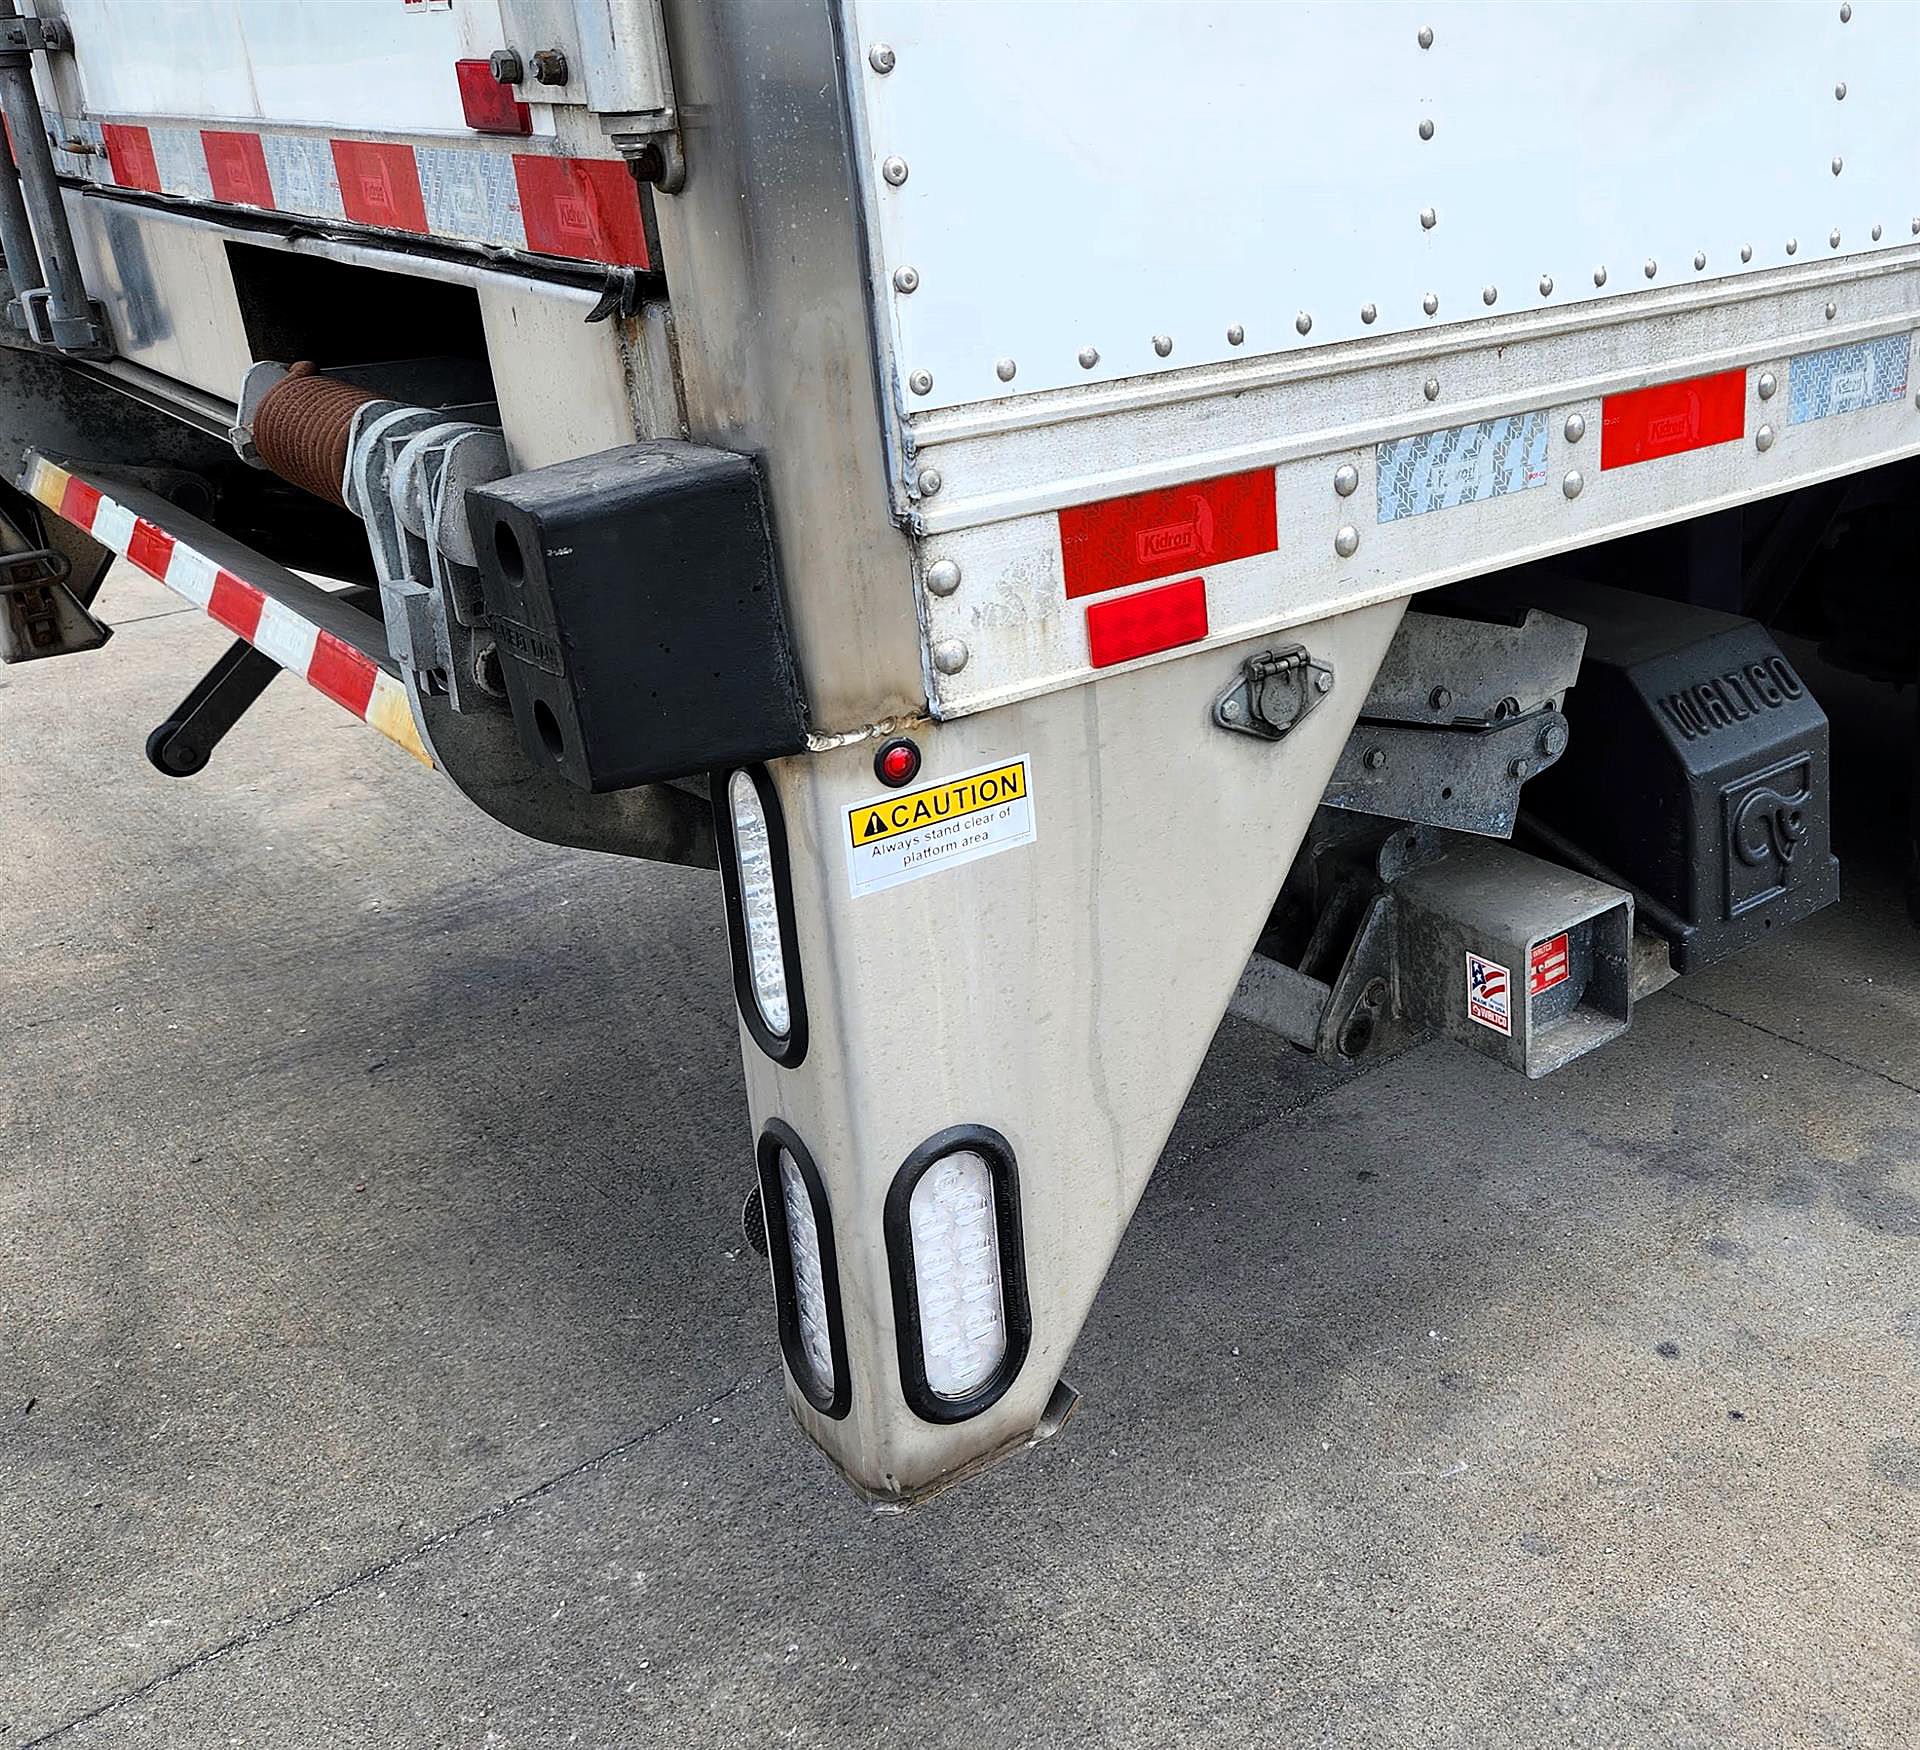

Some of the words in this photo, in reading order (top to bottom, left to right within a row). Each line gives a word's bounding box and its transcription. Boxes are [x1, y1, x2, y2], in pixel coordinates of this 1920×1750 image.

[1143, 531, 1191, 555] Kidron
[1656, 655, 1803, 741] WALTCO
[891, 772, 1018, 828] CAUTION
[871, 836, 920, 858] Always
[924, 822, 960, 842] stand
[964, 813, 995, 830] clear
[999, 805, 1012, 819] of
[903, 841, 957, 867] platform
[961, 831, 989, 847] area
[1479, 1008, 1508, 1028] WALTCO
